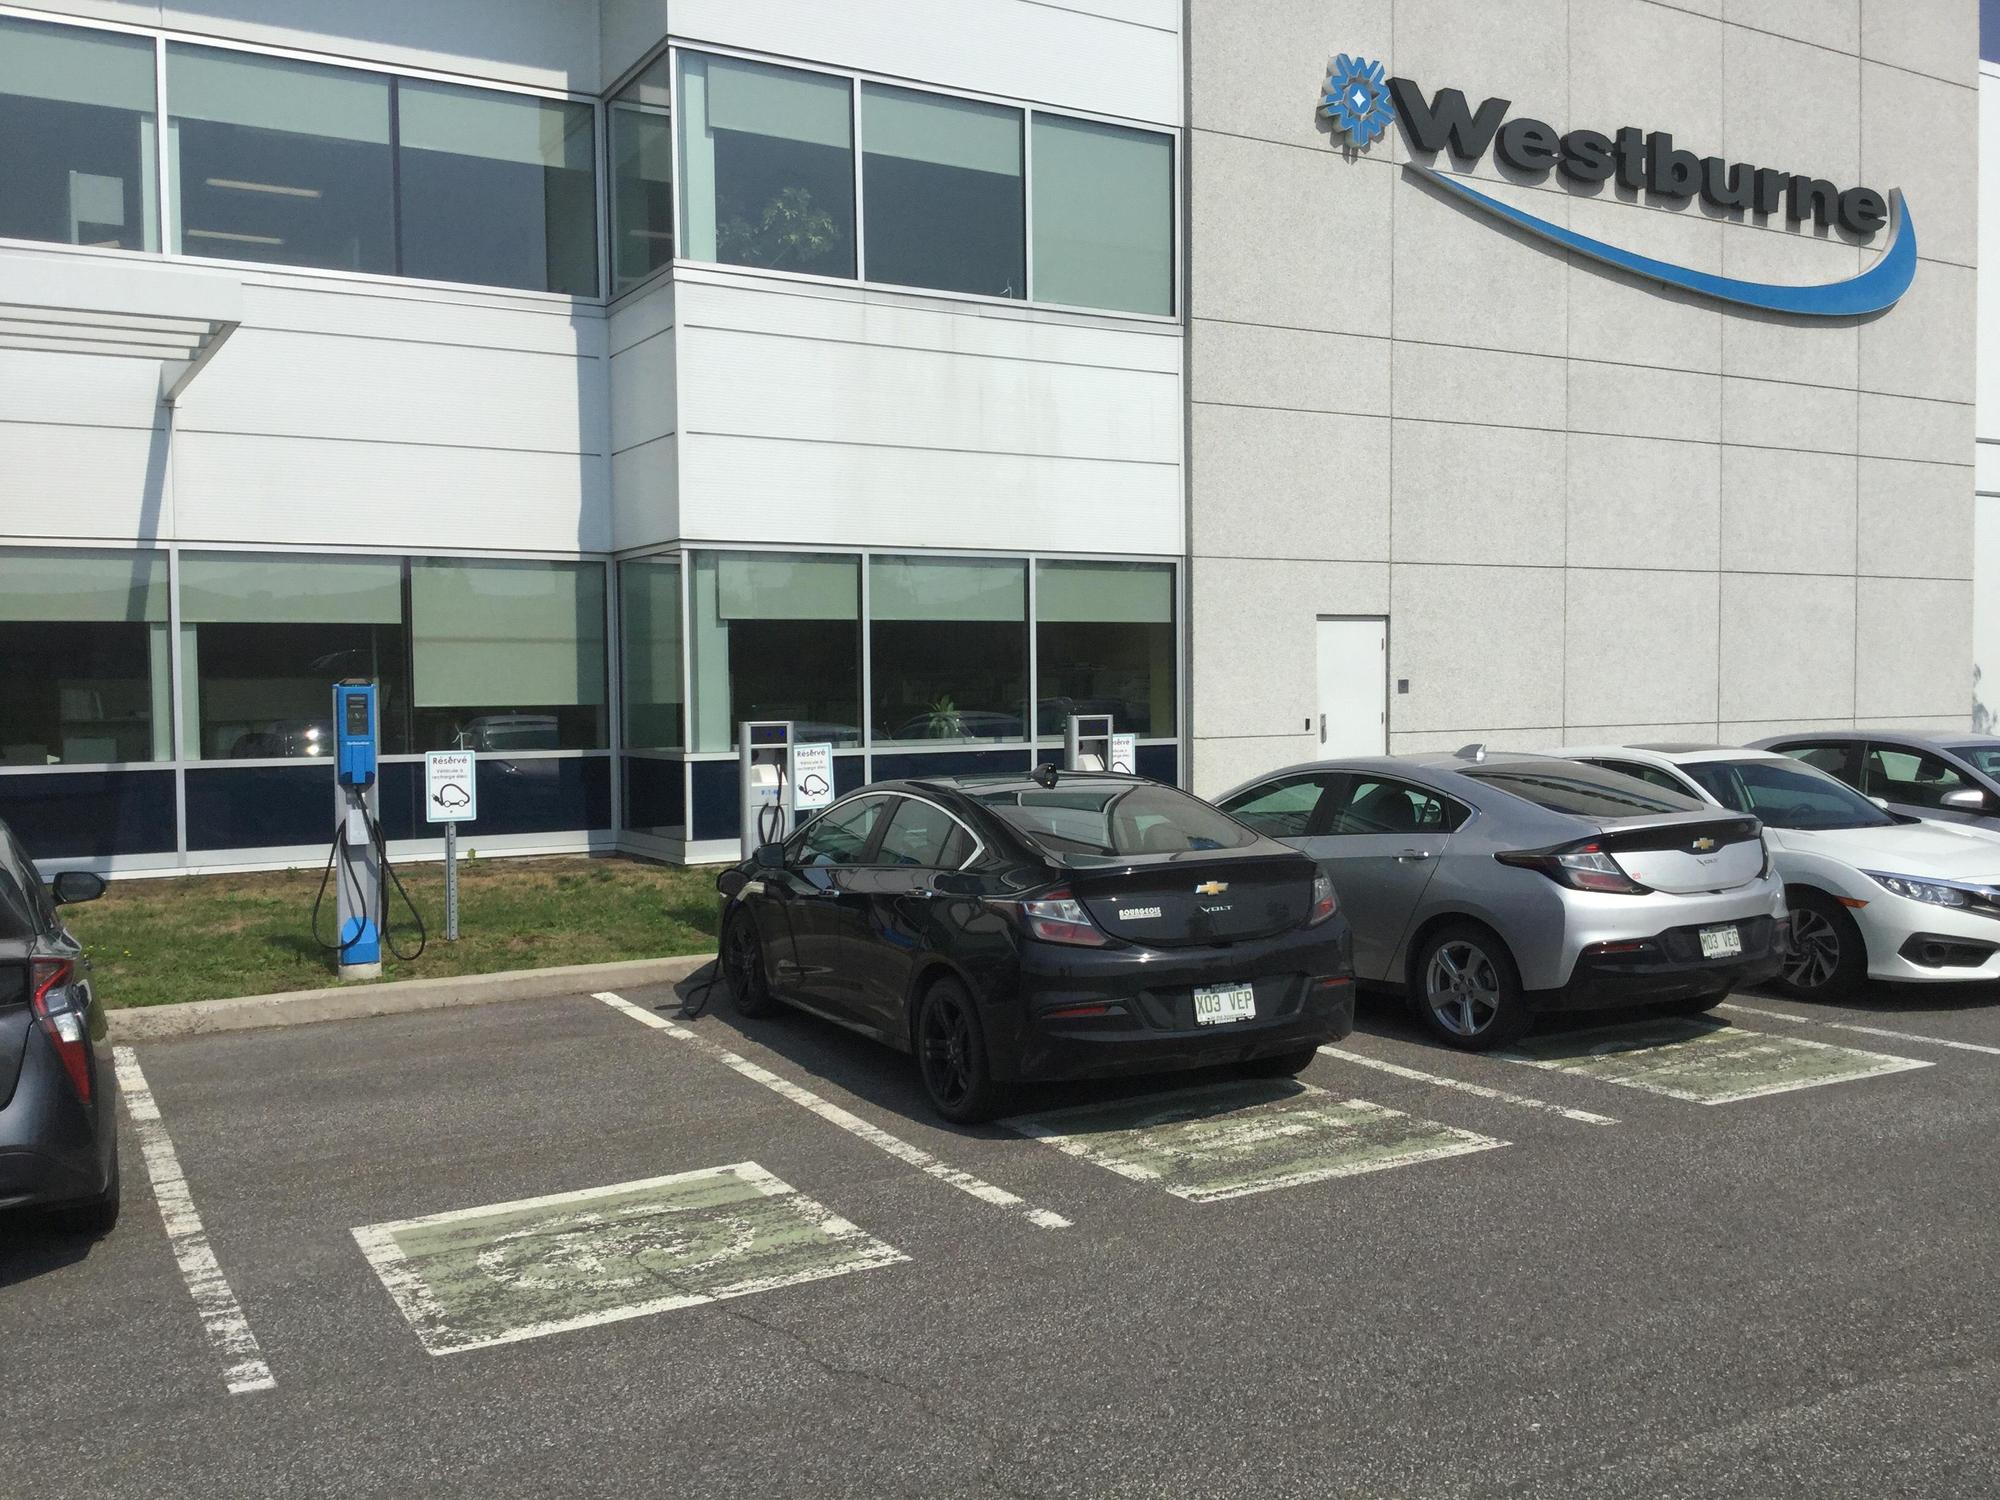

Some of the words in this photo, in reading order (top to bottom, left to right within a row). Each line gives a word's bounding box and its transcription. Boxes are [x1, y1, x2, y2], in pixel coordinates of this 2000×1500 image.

[1388, 77, 1888, 234] Westburne
[1199, 905, 1233, 914] VOLT
[1195, 994, 1221, 1014] X03
[1228, 991, 1252, 1010] VEP
